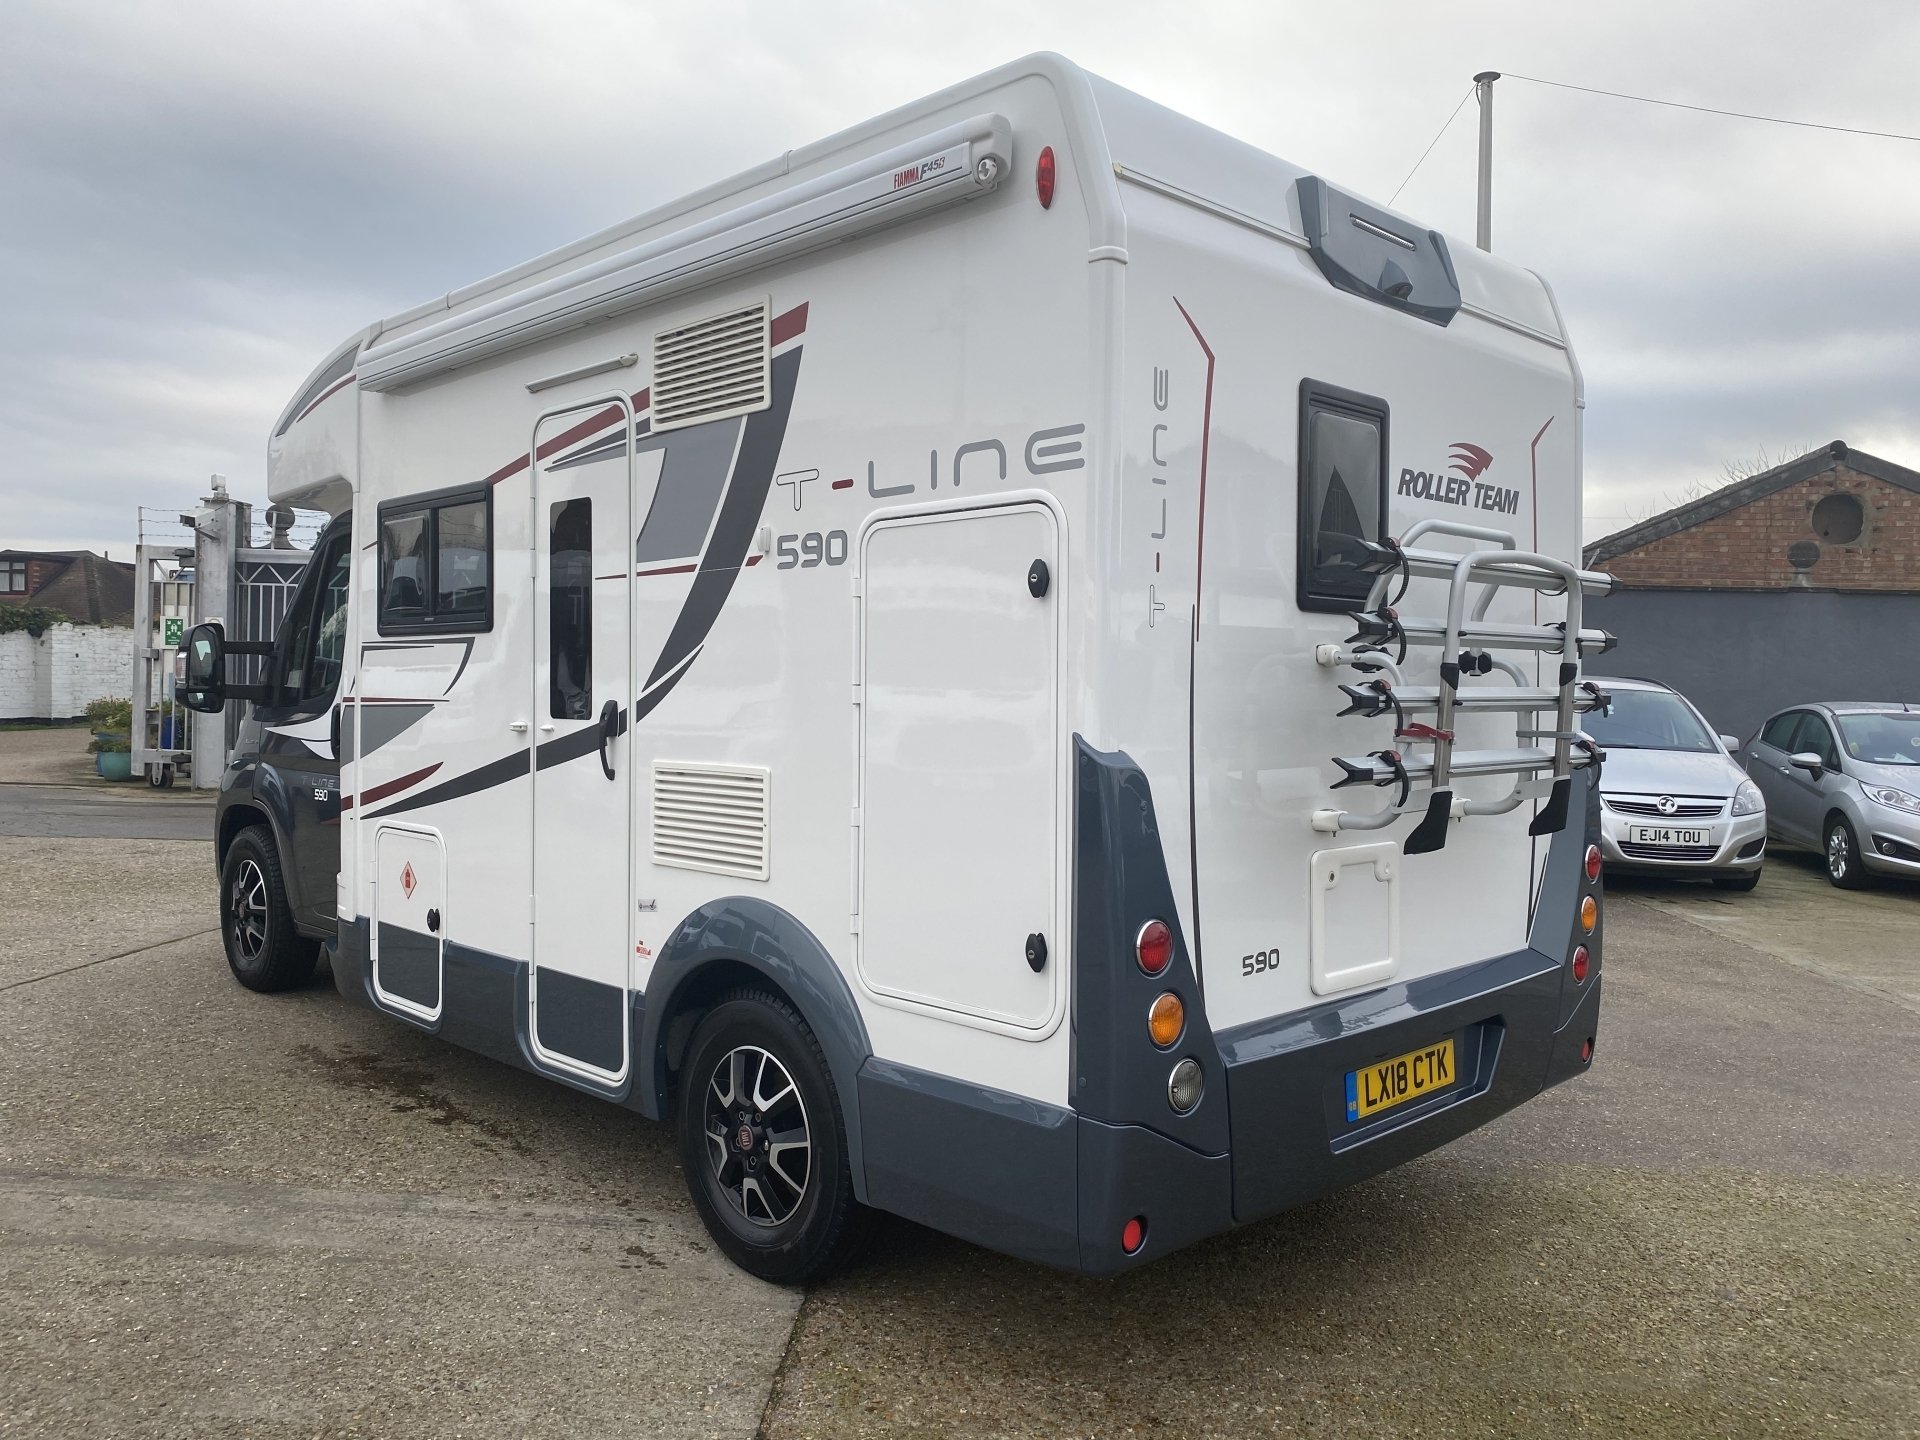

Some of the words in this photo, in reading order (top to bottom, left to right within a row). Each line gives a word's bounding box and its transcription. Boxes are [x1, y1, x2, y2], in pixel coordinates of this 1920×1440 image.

[893, 166, 919, 190] FIAMMA
[776, 423, 1086, 511] T-LINE
[1149, 366, 1169, 628] T-LINE
[1397, 468, 1471, 506] ROLLER
[1473, 481, 1520, 515] TEAM
[776, 529, 848, 570] 590
[314, 788, 329, 801] 590
[1640, 829, 1671, 842] EJ14
[1674, 830, 1701, 843] TOU
[1242, 948, 1280, 977] 590
[1364, 1060, 1408, 1108] LX18
[1413, 1046, 1448, 1089] CTK
